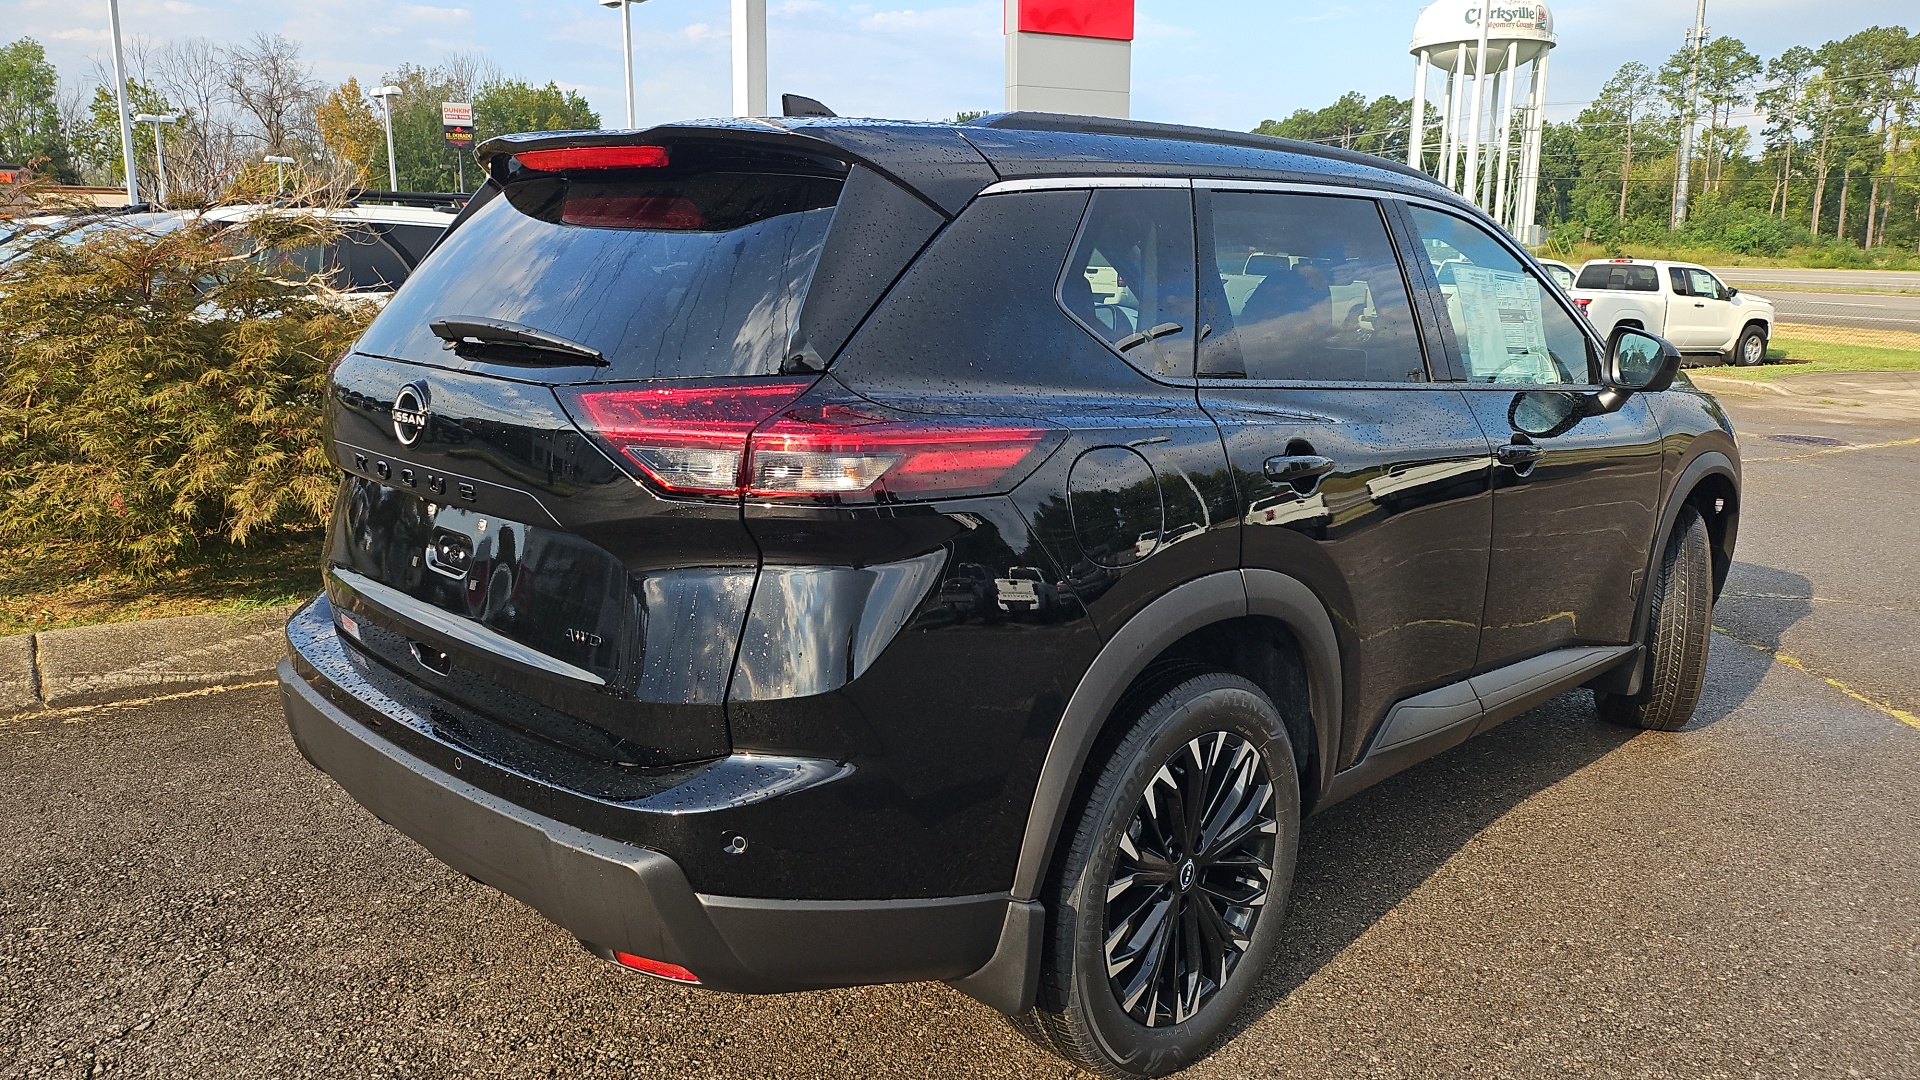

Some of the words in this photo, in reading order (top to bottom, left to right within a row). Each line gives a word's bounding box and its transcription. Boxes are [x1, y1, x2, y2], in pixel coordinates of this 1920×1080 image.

[1465, 7, 1535, 24] Clrksville
[355, 453, 477, 503] ROGUE
[564, 628, 605, 647] AWD
